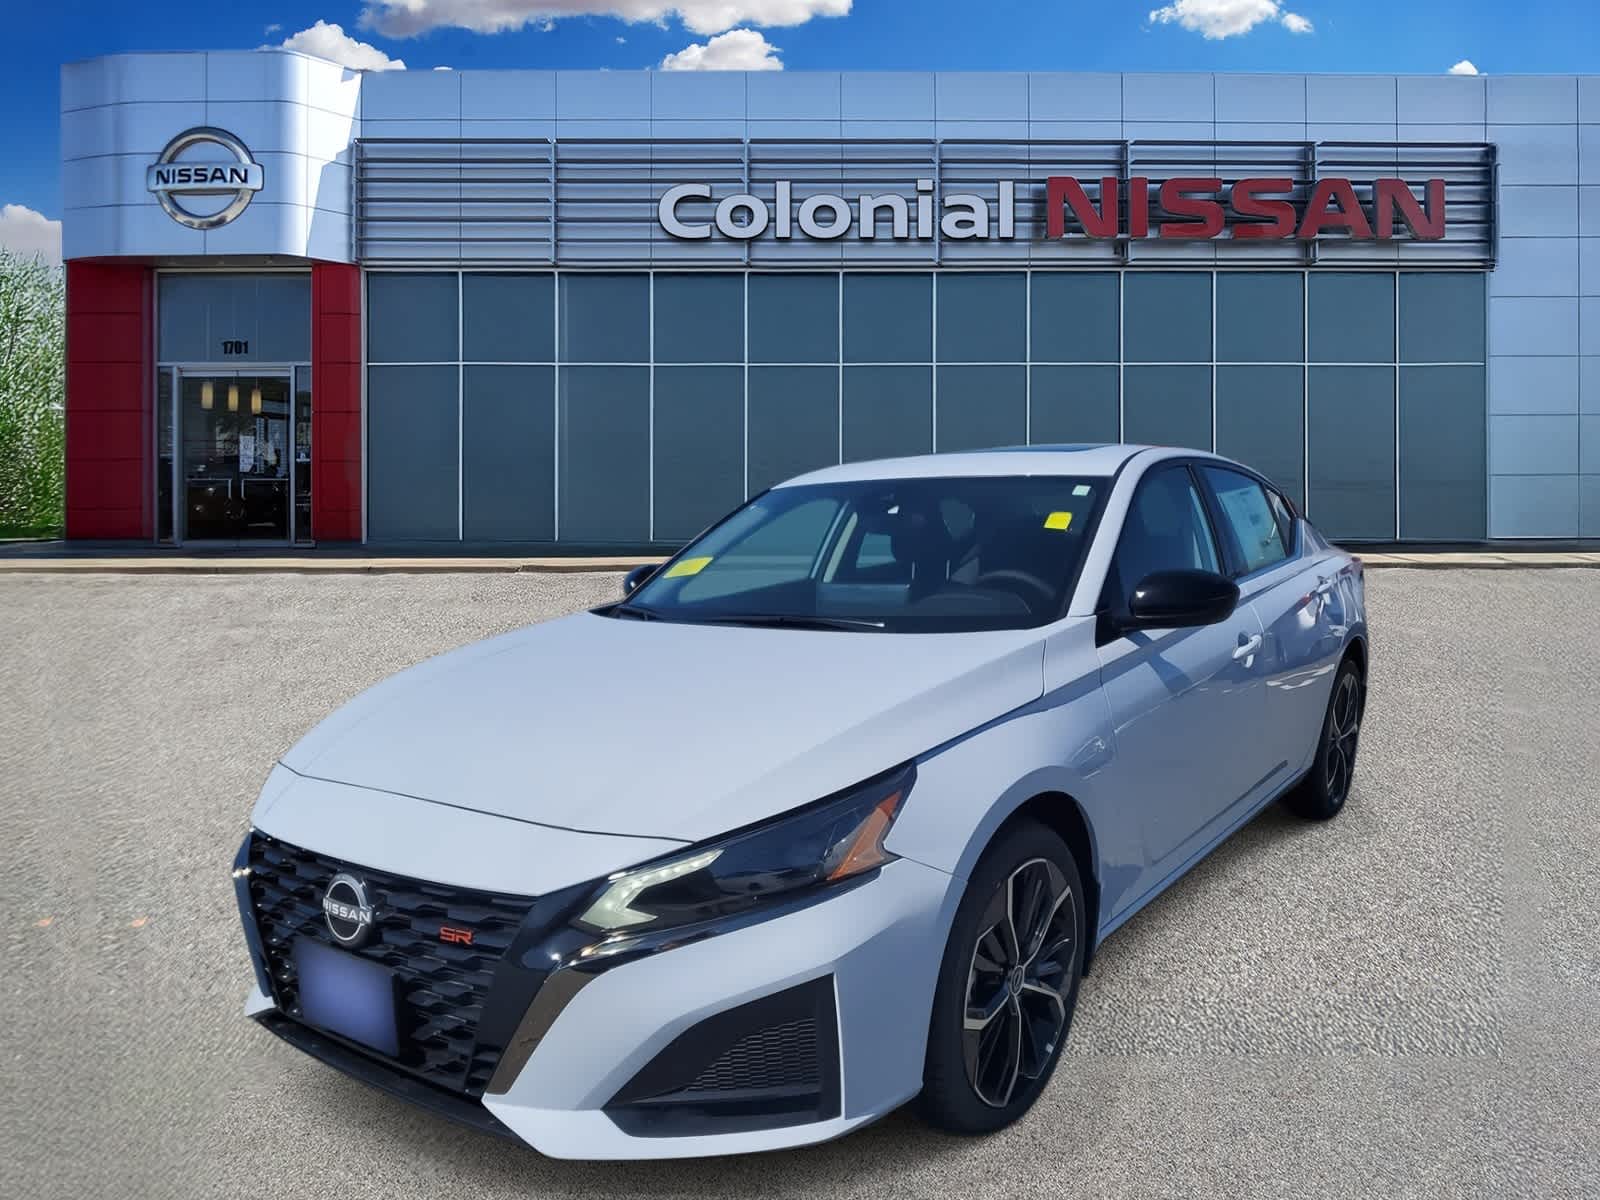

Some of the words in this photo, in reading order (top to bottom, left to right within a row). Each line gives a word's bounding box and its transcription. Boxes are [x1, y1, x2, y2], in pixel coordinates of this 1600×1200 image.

[156, 167, 249, 185] NISSAN
[658, 179, 1015, 240] Colonial
[1046, 176, 1446, 240] NISSAN
[221, 340, 249, 355] 1701
[322, 897, 372, 923] NISSAN
[439, 926, 474, 945] SR
